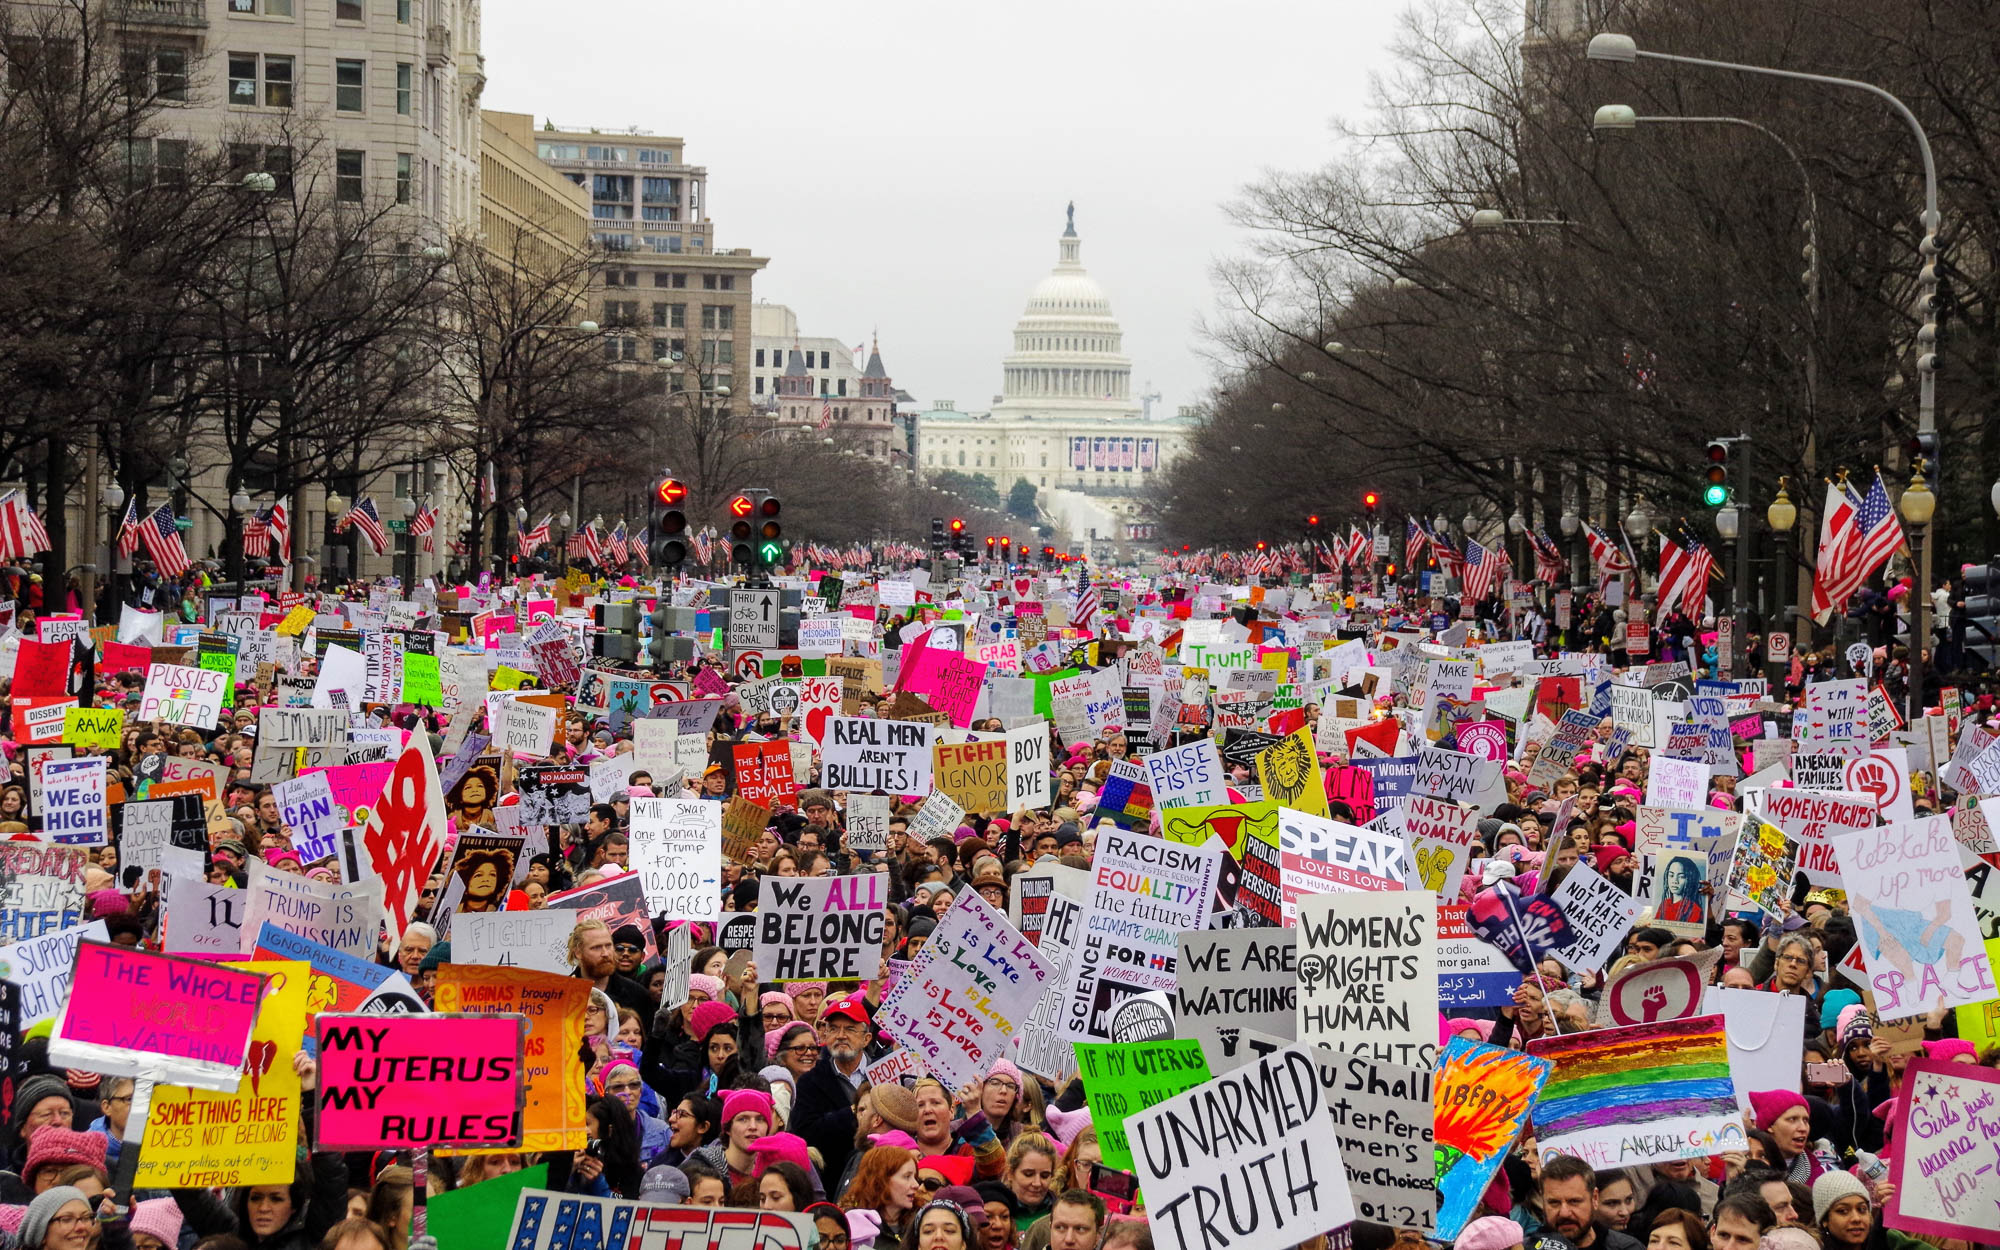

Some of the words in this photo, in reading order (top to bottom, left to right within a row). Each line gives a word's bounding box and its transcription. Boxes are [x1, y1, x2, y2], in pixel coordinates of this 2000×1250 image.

[734, 594, 755, 602] THRU
[804, 598, 825, 606] NOT
[51, 622, 78, 632] LEAST
[410, 633, 431, 642] your
[732, 624, 754, 632] OBEY
[758, 624, 776, 633] THIS
[250, 644, 266, 652] BUT
[732, 635, 761, 644] SIGNAL
[240, 653, 251, 661] WE
[254, 653, 269, 662] ARE
[1540, 662, 1562, 674] YES
[151, 664, 222, 693] PUSSIES
[1438, 664, 1469, 677] MAKE
[1626, 672, 1641, 680] WE
[1053, 680, 1070, 696] Ask
[1072, 680, 1092, 692] what
[1612, 690, 1630, 704] WHO
[1632, 691, 1648, 706] RUN
[1828, 690, 1848, 700] I'M
[30, 707, 62, 720] DISSENT
[144, 698, 211, 728] POWER
[502, 702, 512, 710] We
[1614, 708, 1626, 722] THE
[1626, 708, 1650, 724] WORLD
[1828, 706, 1855, 720] WITH
[76, 718, 117, 734] RAWR
[1559, 722, 1589, 738] YOUR
[1562, 712, 1600, 728] KEEP
[1672, 723, 1698, 736] RESPECT
[1829, 722, 1853, 738] HER
[506, 731, 538, 749] ROAR
[834, 720, 881, 746] REAL
[888, 724, 925, 748] MEN
[1478, 727, 1488, 736] WE
[1668, 735, 1708, 749] EXISTENCE
[1014, 736, 1043, 764] BOY
[1550, 739, 1566, 748] OUT
[1566, 742, 1577, 750] OF
[1608, 742, 1622, 758] NO
[1680, 748, 1692, 756] OR
[736, 758, 752, 767] THE
[858, 748, 907, 767] AREN'T
[1149, 744, 1212, 778] RAISE
[1419, 751, 1478, 776] NASTY
[541, 774, 552, 782] NO
[552, 773, 584, 781] MAJORITY
[739, 772, 750, 783] IS
[1113, 762, 1140, 779] THIS
[1154, 766, 1210, 795] FISTS
[1664, 762, 1692, 778] GIRLS
[1798, 771, 1842, 784] FAMILIES
[741, 784, 793, 799] FEMALE
[1016, 770, 1042, 798] BYE
[1658, 786, 1676, 798] HAVE
[47, 788, 80, 808] WE
[82, 792, 101, 804] GO
[1196, 790, 1212, 804] IT
[47, 808, 102, 831] HIGH
[284, 796, 331, 827] CAN
[1410, 798, 1473, 827] NASTY
[1828, 802, 1876, 828] RIGHTS
[304, 822, 318, 840] U
[510, 825, 529, 836] I'M
[634, 830, 656, 841] one
[663, 828, 706, 840] Donald
[848, 816, 884, 833] FREE
[1406, 818, 1473, 847] WOMEN
[1802, 822, 1826, 838] ARE
[662, 842, 704, 854] Trump
[849, 831, 888, 846] BARRON
[297, 834, 336, 866] NOT
[1106, 836, 1202, 874] RACISM
[1102, 856, 1138, 870] CRIMINAL
[1140, 864, 1170, 878] JUSTICE
[1171, 872, 1200, 885] REFORM
[1200, 858, 1213, 897] PLANNED
[1286, 873, 1302, 886] NO
[1300, 859, 1334, 878] LOVE
[1338, 870, 1350, 881] IS
[1354, 874, 1388, 892] LOVE
[771, 882, 811, 910] We
[822, 872, 883, 913] ALL
[1096, 866, 1198, 906] EQUALITY
[264, 890, 320, 922] TRUMP
[336, 904, 354, 924] IS
[1094, 890, 1125, 913] the
[1129, 900, 1191, 929] future
[1566, 881, 1594, 904] NOT
[1592, 902, 1626, 931] HATE
[761, 912, 884, 945] BELONG
[1088, 915, 1144, 939] CLIMATE
[1301, 907, 1425, 948] WOMEN'S
[1564, 901, 1608, 938] MAKES
[470, 918, 554, 952] FIGHT
[958, 894, 994, 931] Love
[1010, 940, 1046, 982] Love
[265, 932, 346, 972] IGNORANCE
[962, 928, 980, 948] is
[982, 943, 1020, 984] Love
[1106, 944, 1146, 968] FOR
[1184, 942, 1230, 974] WE
[1242, 942, 1297, 973] ARE
[1446, 944, 1472, 955] odio.
[776, 946, 860, 980] HERE
[936, 934, 950, 956] is
[951, 946, 997, 994] Love
[1326, 956, 1419, 986] RIGHTS
[1460, 956, 1490, 970] gana!
[96, 950, 152, 986] THE
[168, 962, 257, 1004] WHOLE
[1069, 934, 1102, 1033] SCIENCE
[1102, 965, 1150, 985] WOMEN'S
[1467, 977, 1475, 988] لا
[462, 986, 514, 1002] VAGINAS
[521, 986, 564, 1002] brought
[1343, 984, 1386, 1004] ARE
[1458, 989, 1486, 1004] الحب
[518, 1002, 544, 1016] this
[922, 979, 940, 999] is
[938, 988, 984, 1036] Love
[974, 996, 1014, 1036] Love
[1304, 1001, 1410, 1033] HUMAN
[322, 1026, 391, 1052] MY
[890, 1006, 907, 1028] is
[906, 1019, 940, 1058] Love
[926, 1006, 944, 1028] is
[941, 1018, 983, 1060] Love
[354, 1056, 514, 1082] UTERUS
[1084, 1049, 1098, 1078] IF
[1106, 1049, 1126, 1076] MY
[1133, 1047, 1204, 1076] UTERUS
[527, 1066, 549, 1082] you
[320, 1086, 387, 1110] MY
[1094, 1092, 1128, 1117] FIRED
[152, 1099, 241, 1126] SOMETHING
[248, 1097, 288, 1122] HERE
[1136, 1050, 1318, 1180] UNARMED
[1910, 1100, 1960, 1139] Girls
[1962, 1088, 1994, 1132] just
[151, 1128, 192, 1148] DOES
[202, 1126, 230, 1146] NOT
[235, 1123, 288, 1144] BELONG
[380, 1111, 520, 1146] RULES!
[159, 1161, 186, 1176] your
[224, 1156, 241, 1168] out
[243, 1153, 255, 1168] of
[1918, 1136, 1976, 1178] wanna
[1372, 1168, 1436, 1190] Choices
[1155, 1138, 1319, 1250] TRUTH
